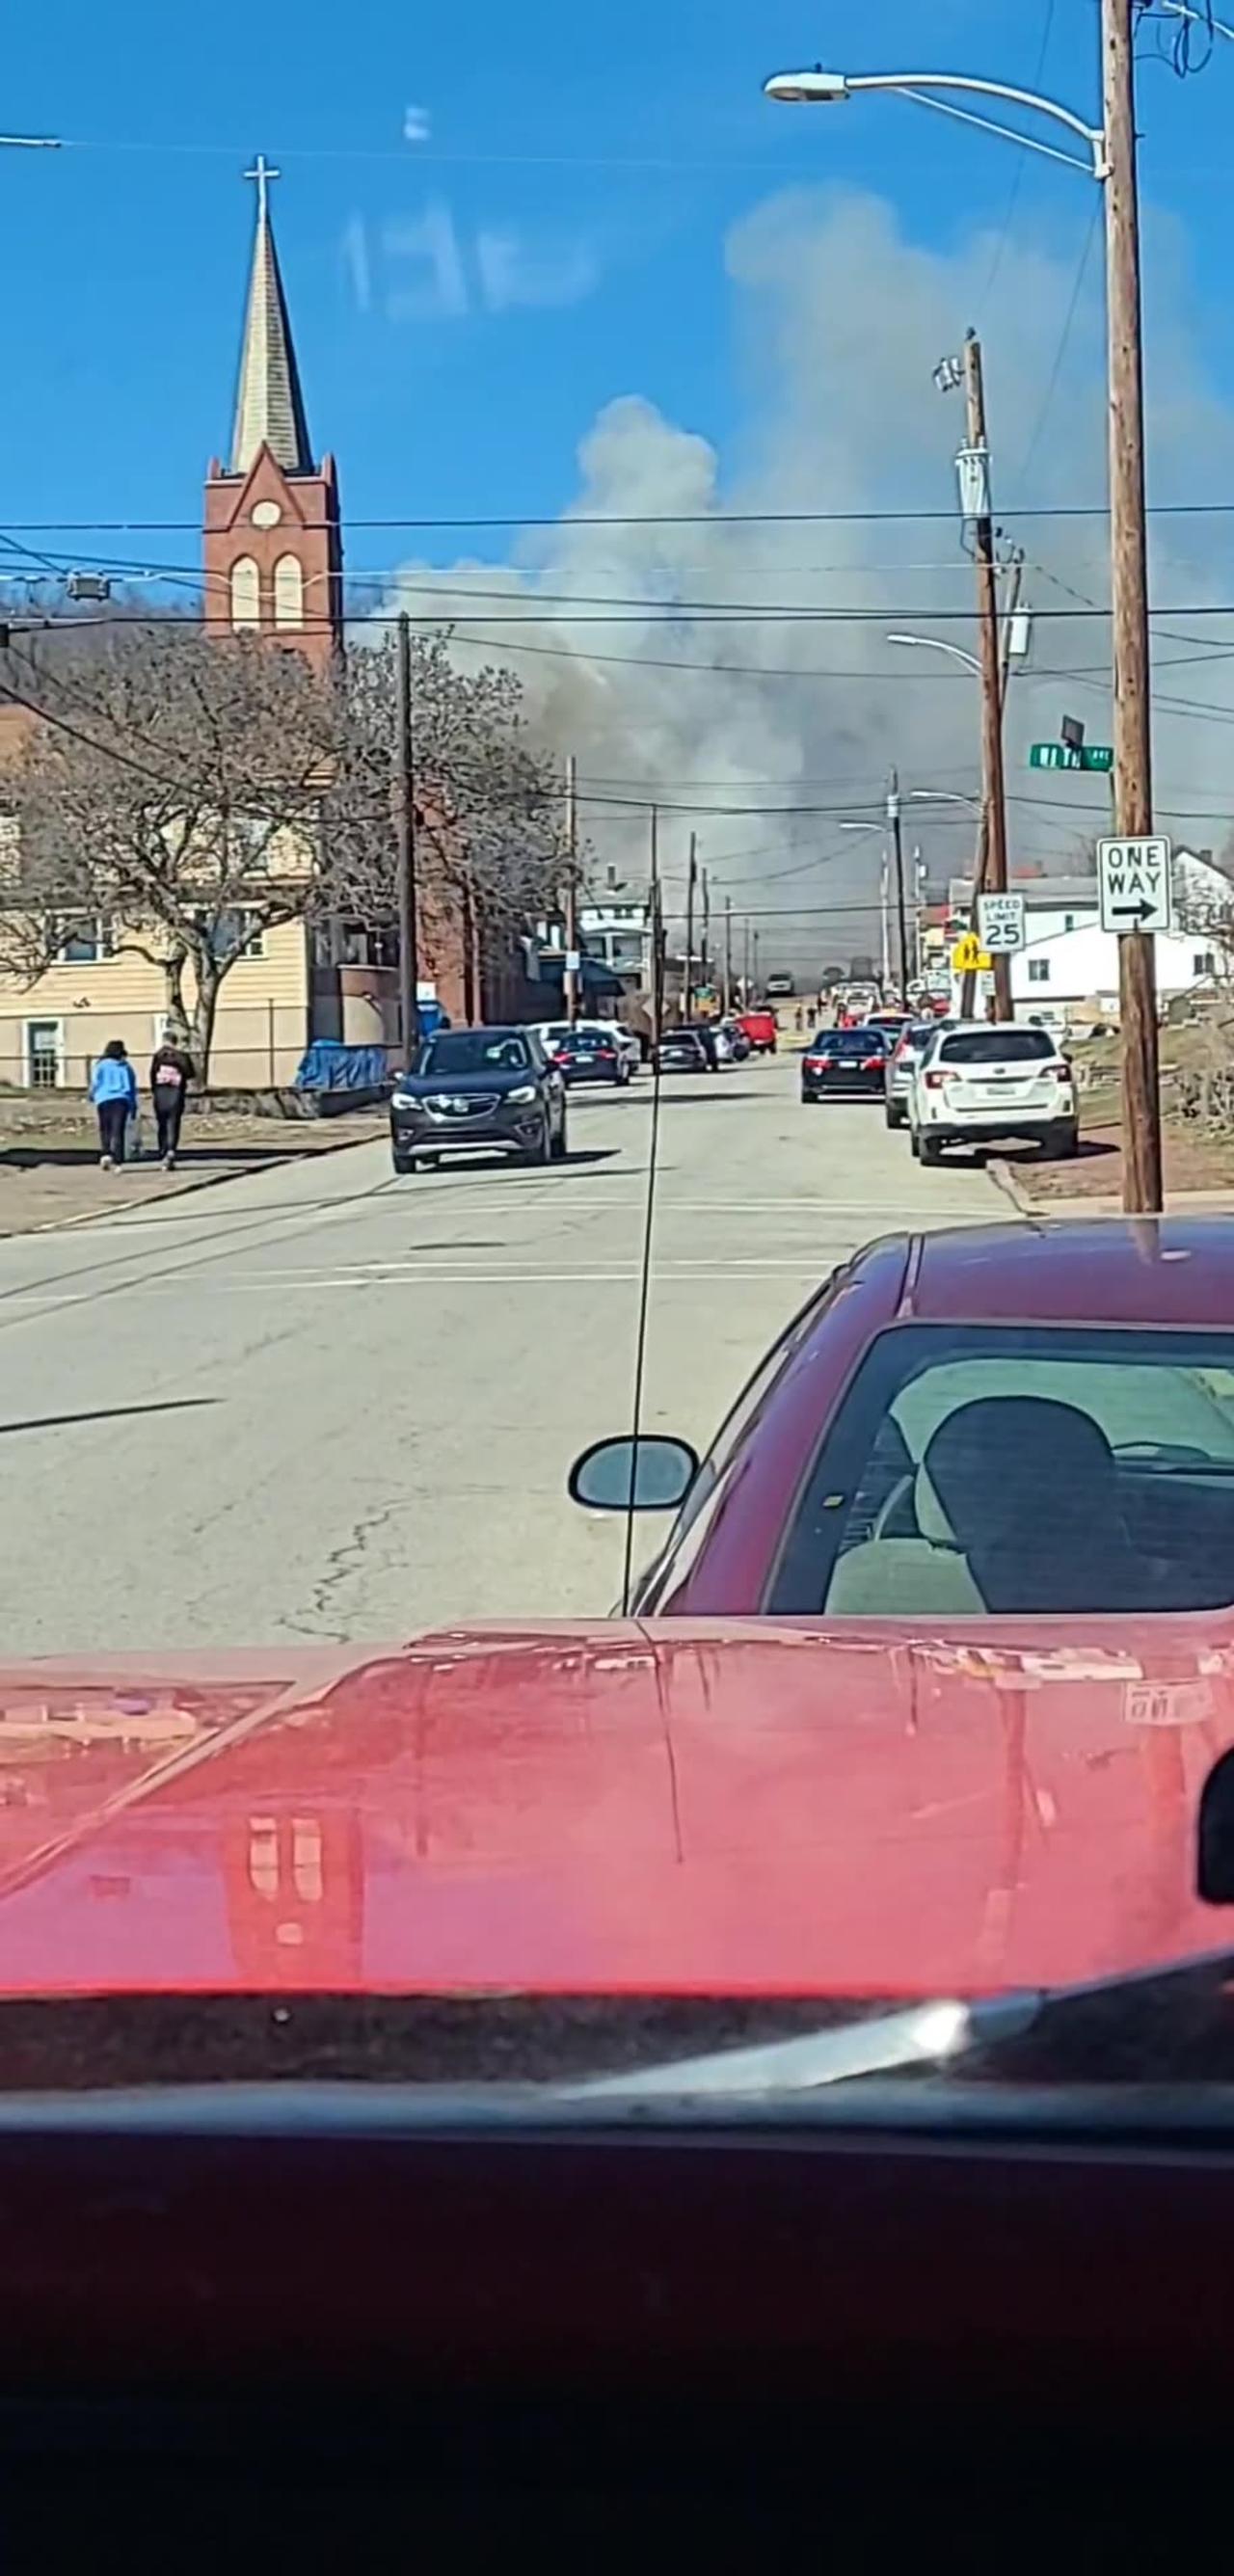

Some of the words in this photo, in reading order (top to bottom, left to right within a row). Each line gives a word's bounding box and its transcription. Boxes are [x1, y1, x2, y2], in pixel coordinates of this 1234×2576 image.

[1108, 845, 1160, 868] ONE
[1108, 871, 1161, 895] WAY
[983, 899, 1021, 910] SPEED
[986, 911, 1015, 922] LIMIT
[985, 924, 1020, 946] 25
